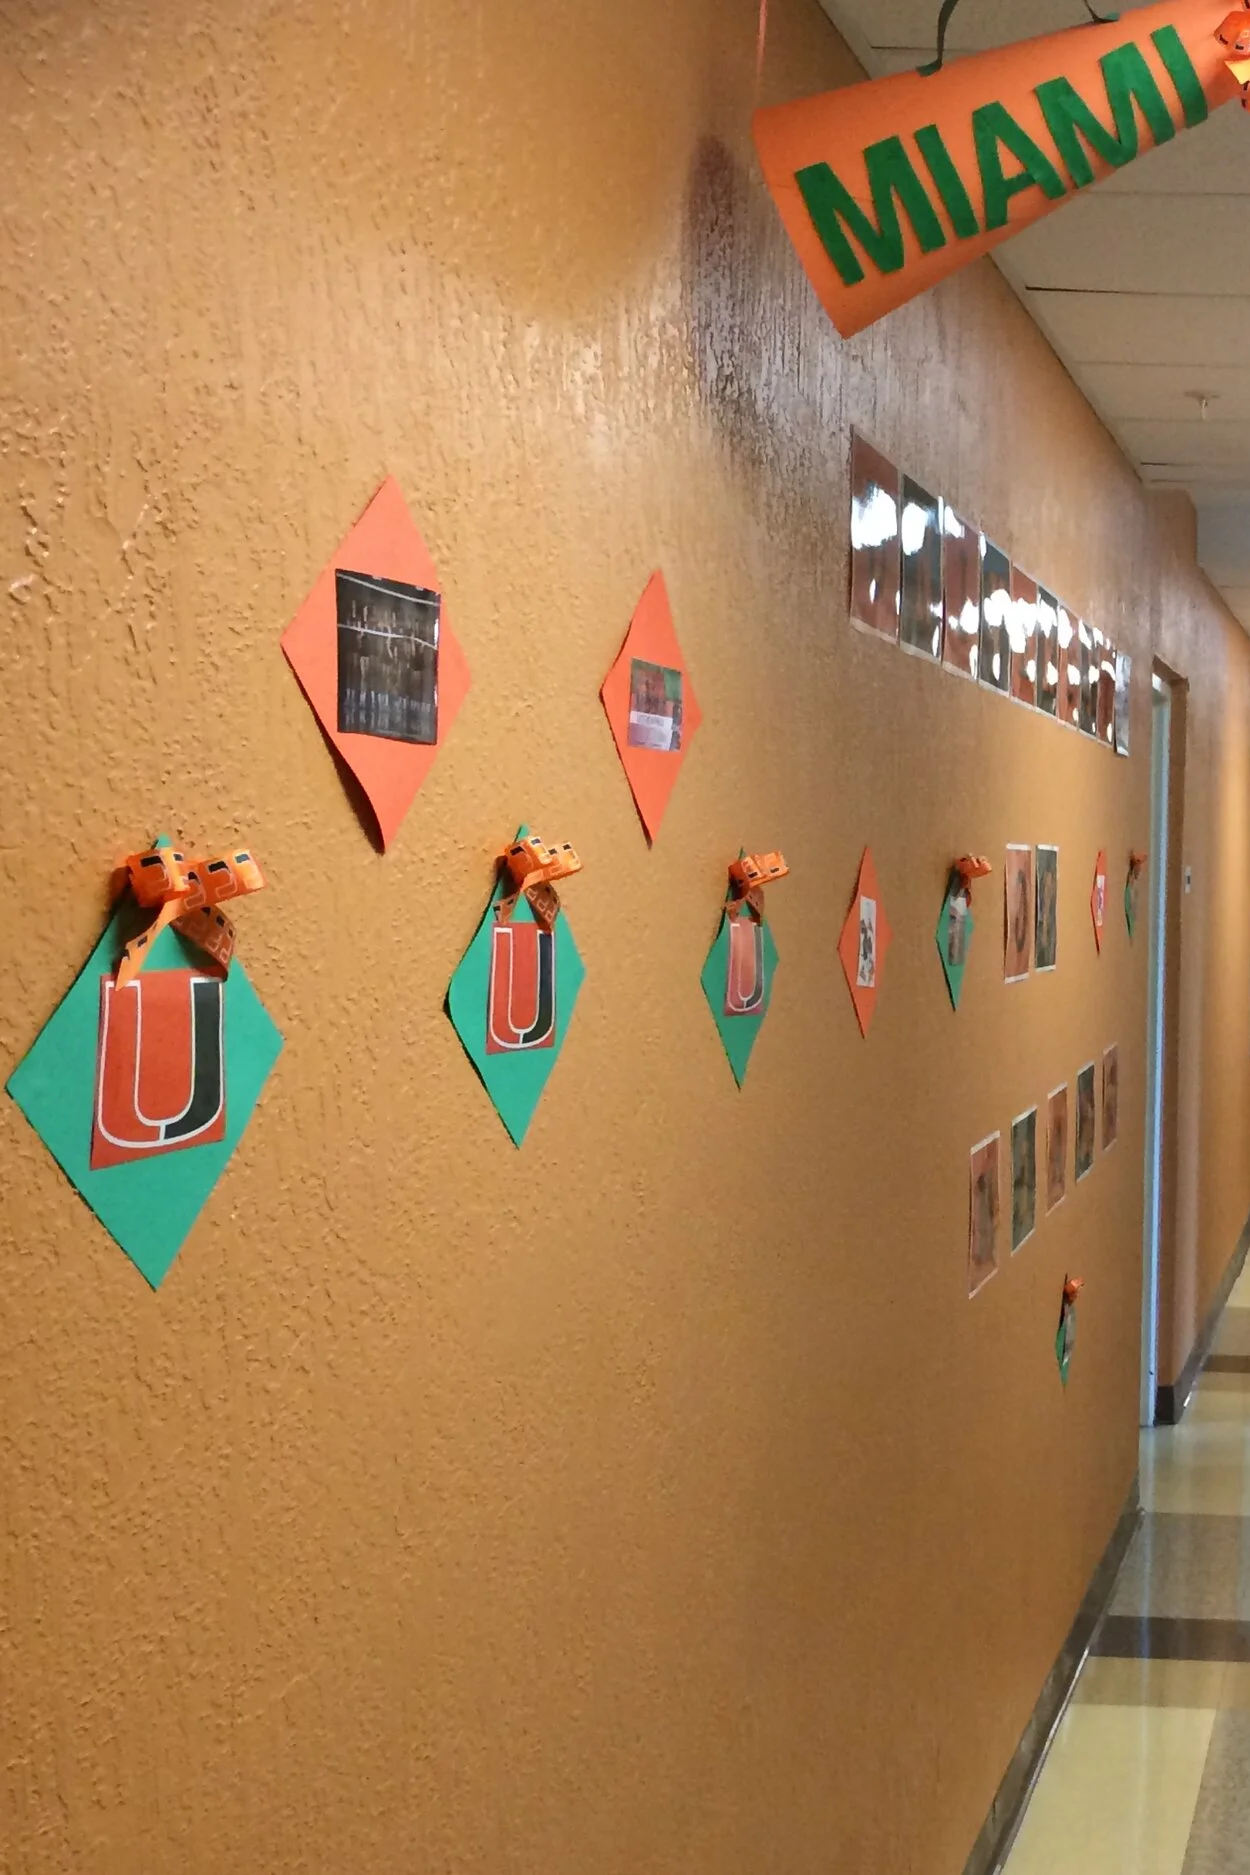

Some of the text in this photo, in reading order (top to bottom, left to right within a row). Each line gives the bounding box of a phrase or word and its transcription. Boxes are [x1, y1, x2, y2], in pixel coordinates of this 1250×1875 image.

[794, 23, 1209, 287] MIAMI
[490, 926, 555, 1049] U
[727, 922, 765, 1012] U
[98, 976, 224, 1149] U
